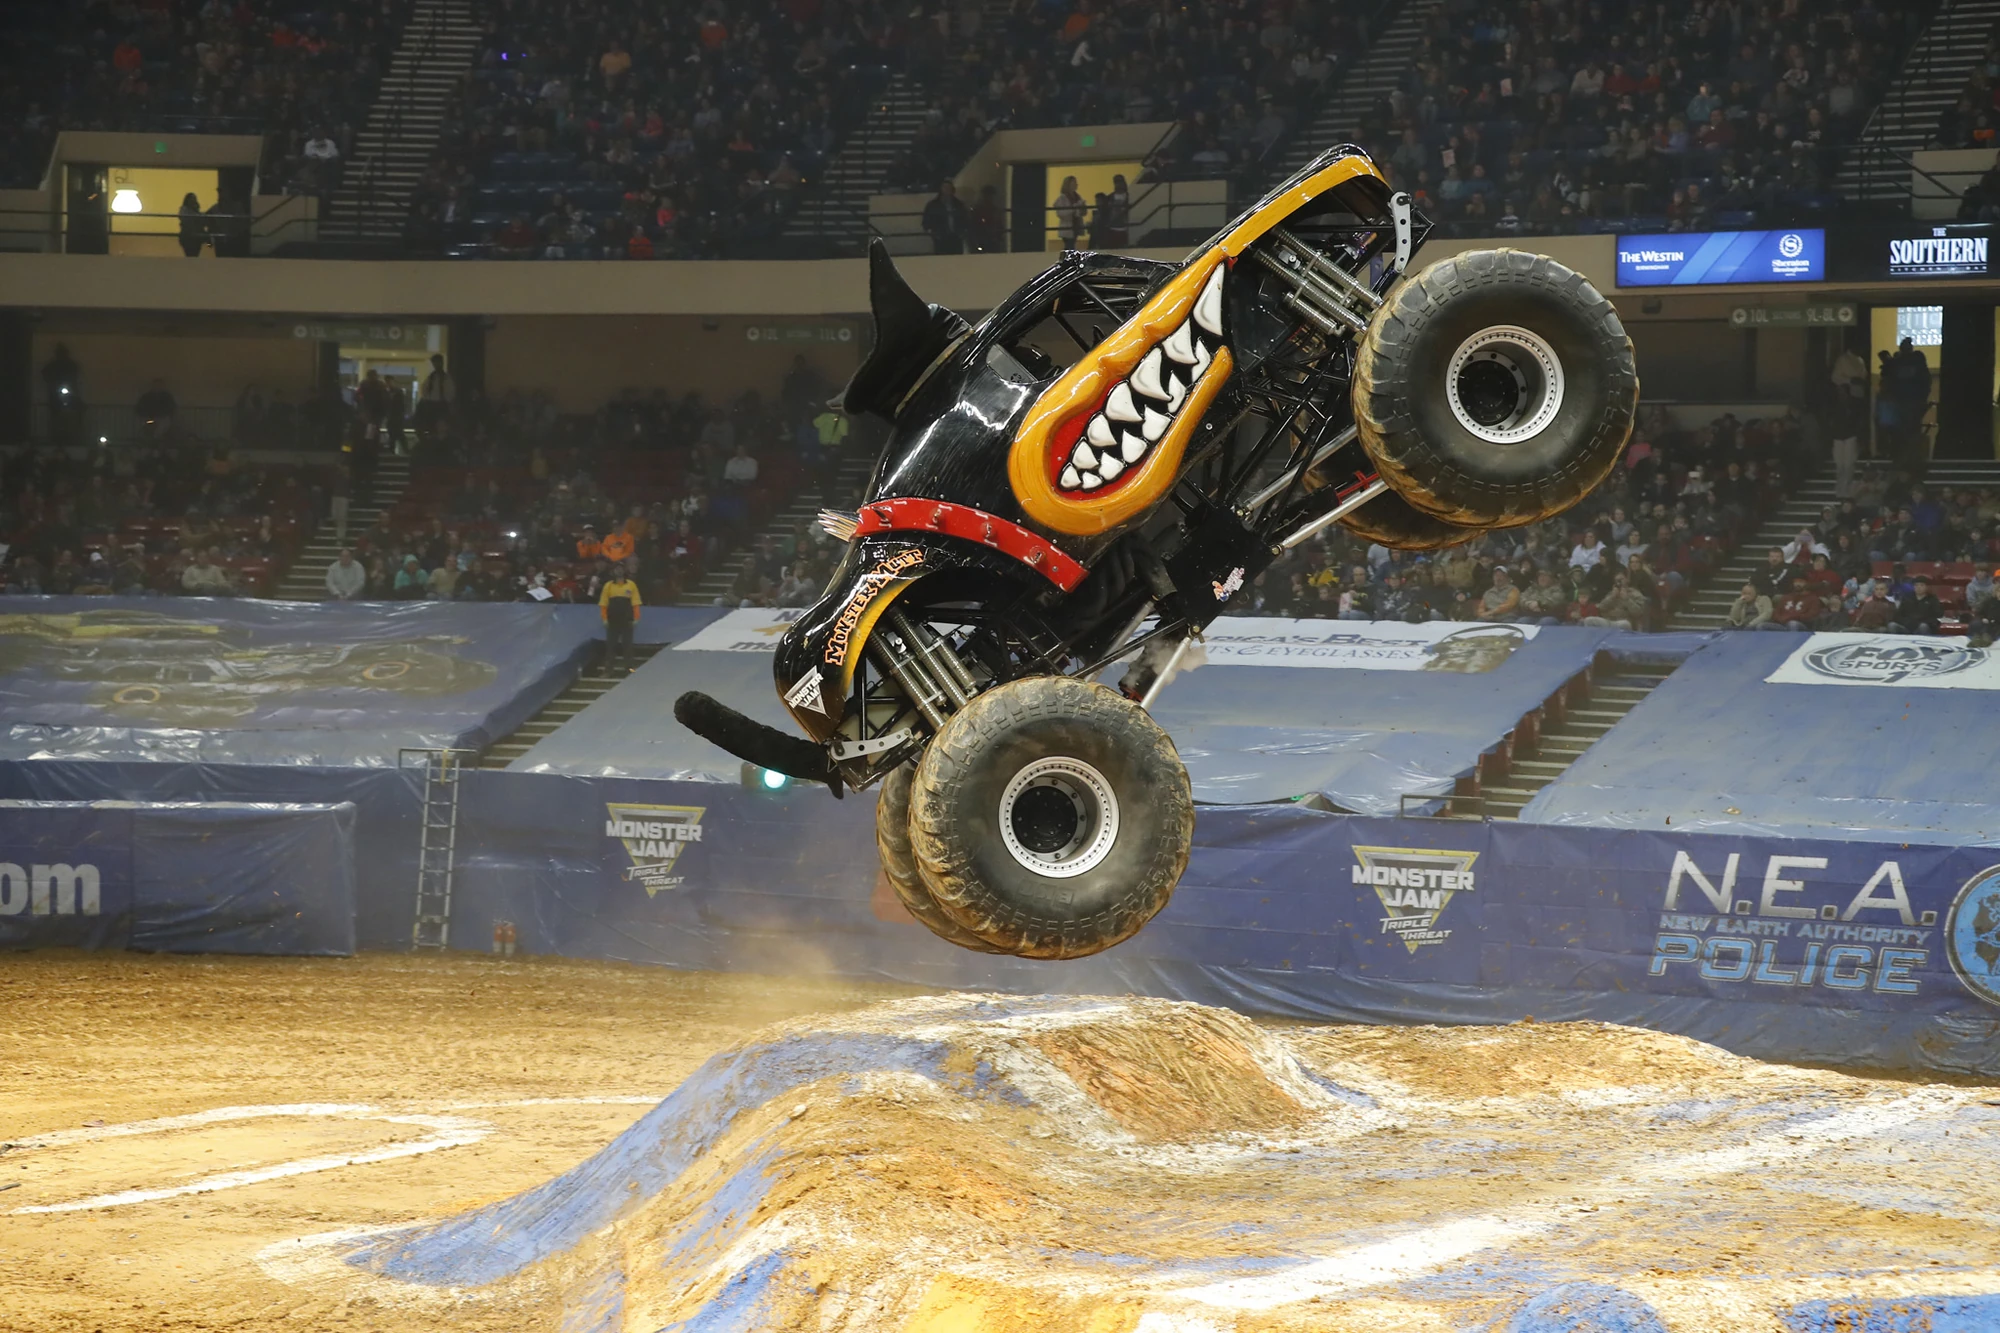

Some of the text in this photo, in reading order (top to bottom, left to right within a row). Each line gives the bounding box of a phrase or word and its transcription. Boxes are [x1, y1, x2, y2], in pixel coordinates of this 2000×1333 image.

[1932, 227, 1947, 237] THE
[1619, 250, 1685, 263] THE WESTIN
[1889, 237, 1989, 264] SOUTHERN
[1771, 259, 1810, 267] Sheraton
[824, 549, 925, 666] MONSTER MUTT
[1845, 646, 1954, 662] FOX
[1838, 660, 1942, 671] SPORTS
[788, 672, 824, 709] MONSTER
[801, 689, 821, 707] JAM
[606, 820, 702, 842] MONSTER
[631, 840, 676, 859] JAM
[626, 863, 669, 881] TRIPLE
[640, 875, 685, 886] THREAT
[1352, 865, 1475, 891] MONSTER
[1664, 850, 1938, 926] N.E.A.
[1385, 888, 1441, 910] JAM
[1380, 914, 1432, 934] TRIPLE
[1660, 914, 1933, 945] NEW EARTH AUTHORITY
[1396, 928, 1452, 940] THREAT
[1648, 932, 1930, 996] POLICE
